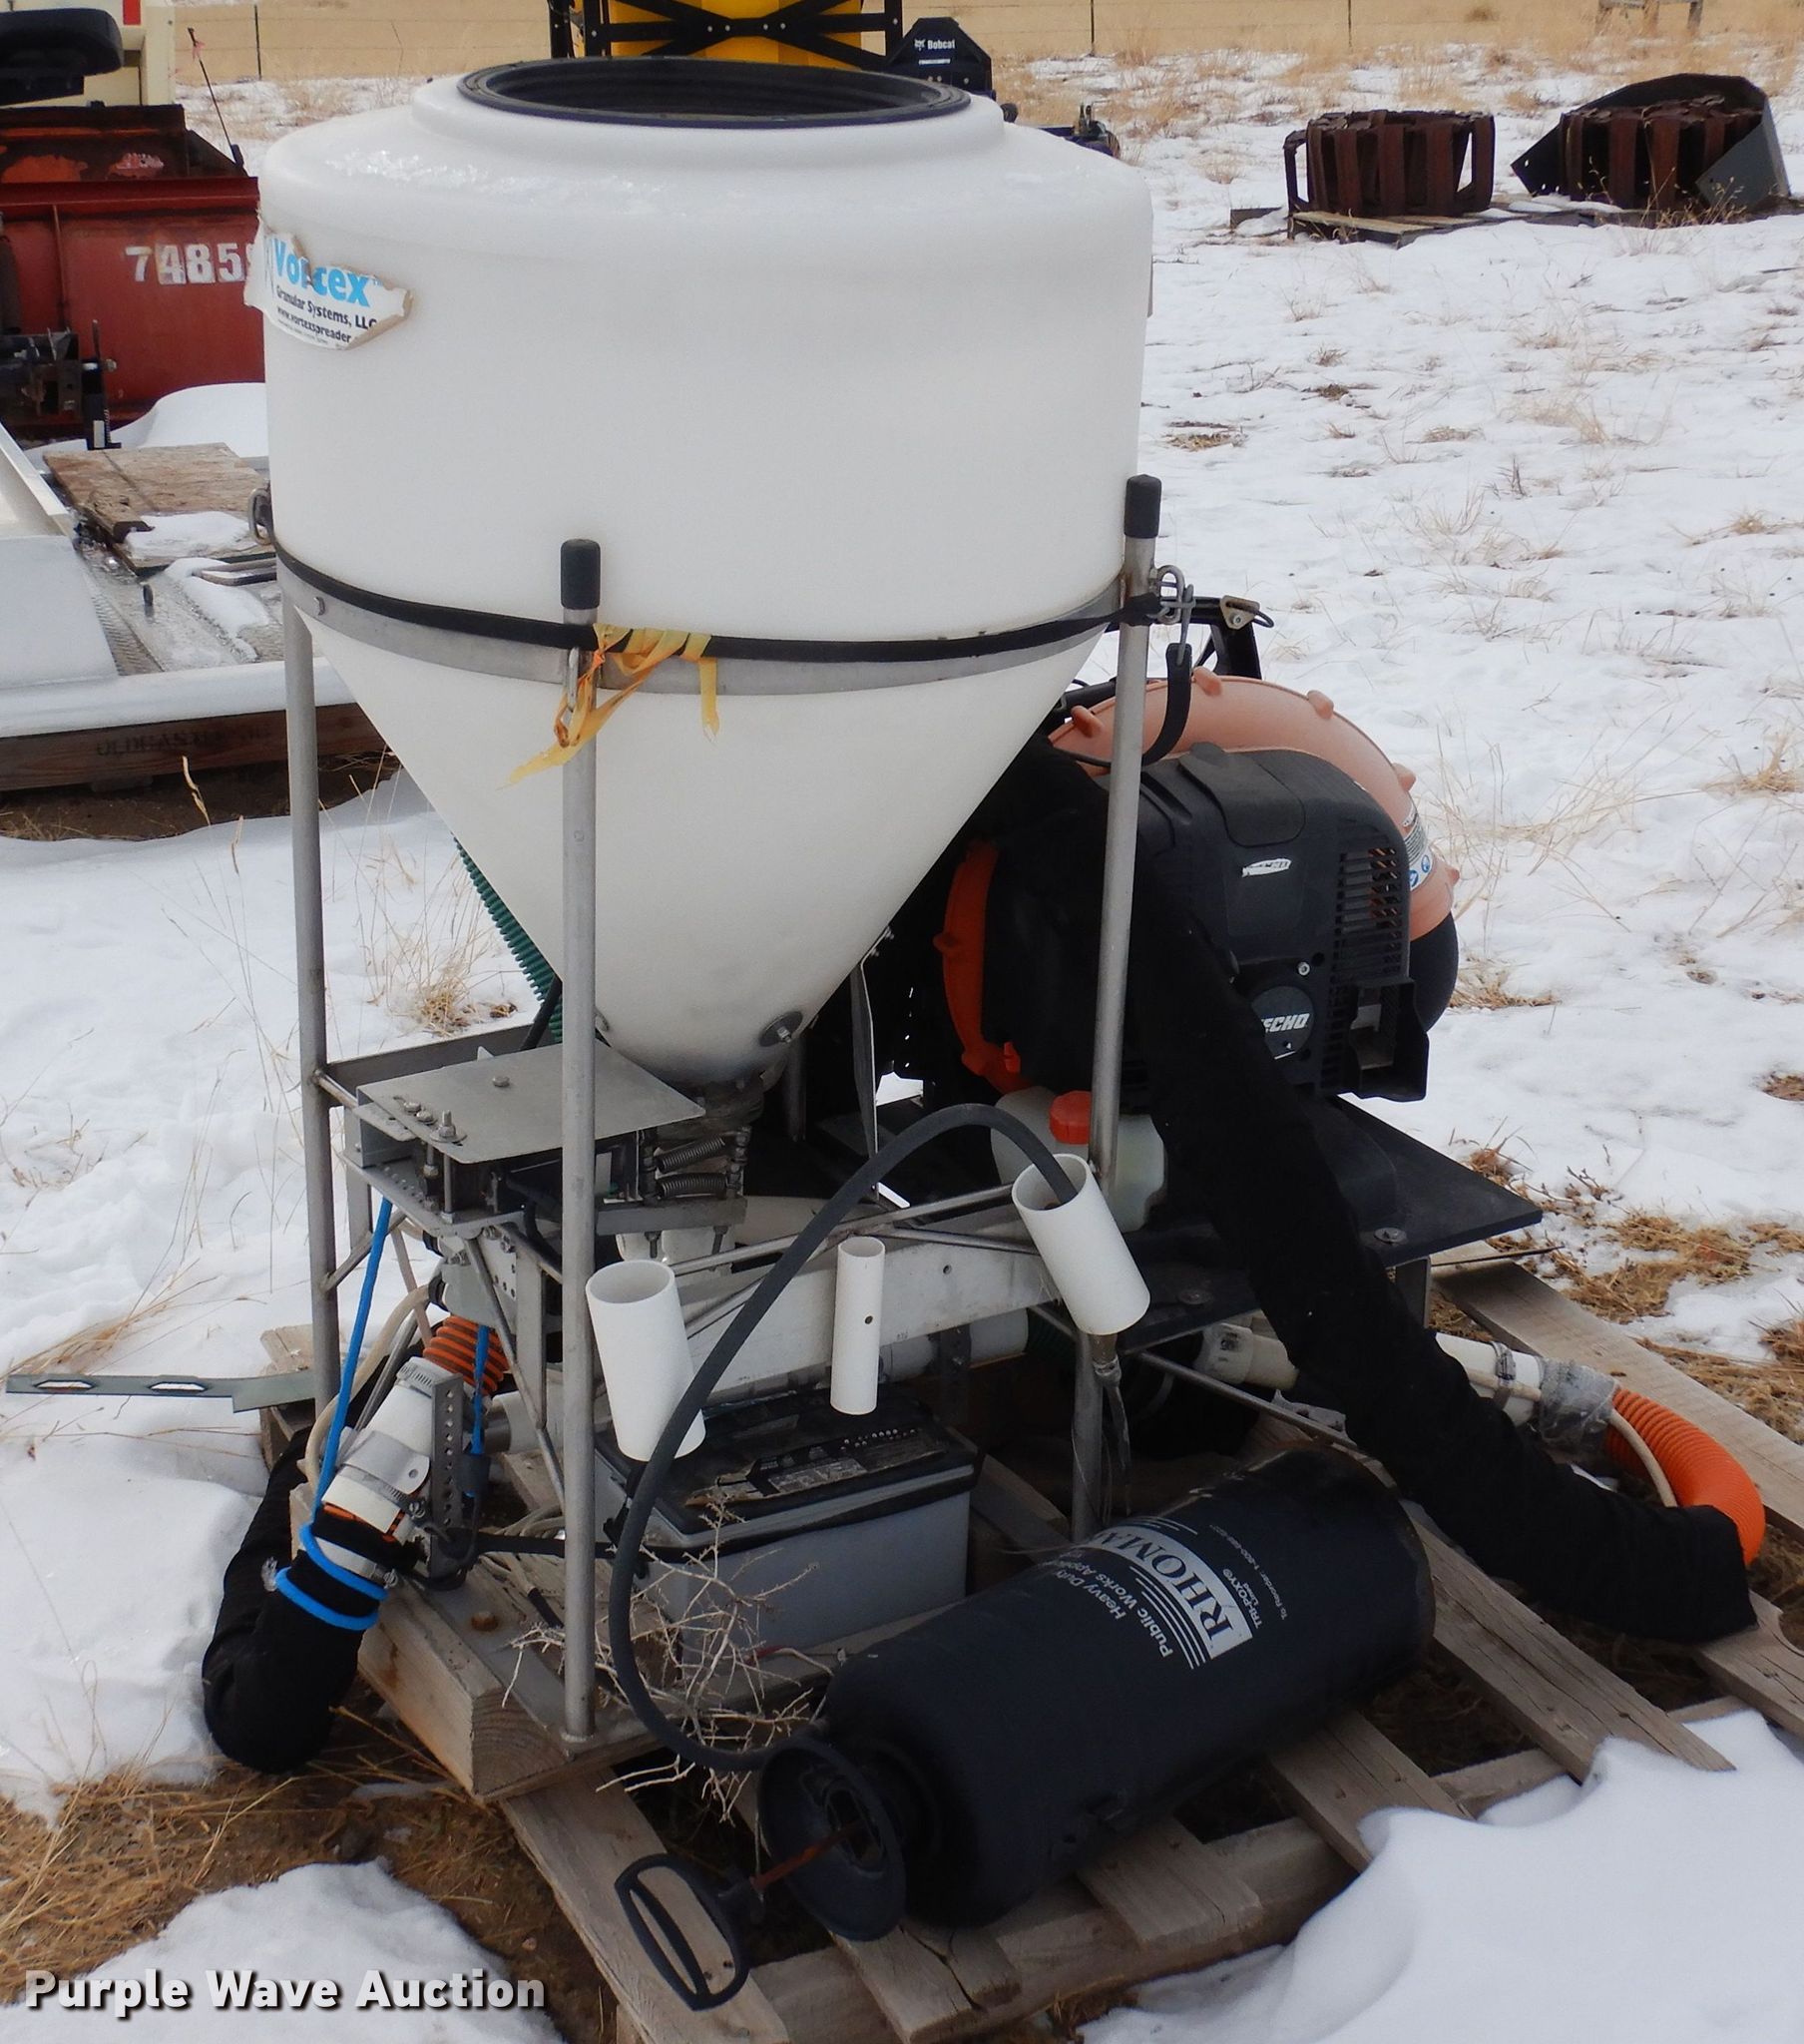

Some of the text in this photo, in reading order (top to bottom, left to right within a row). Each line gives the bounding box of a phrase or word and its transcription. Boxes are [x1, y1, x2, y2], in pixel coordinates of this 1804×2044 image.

[927, 39, 956, 50] Bobcat
[307, 298, 352, 328] Systems,
[1055, 1568, 1128, 1621] Heavy Duty
[1095, 1572, 1139, 1610] Works
[1136, 1609, 1174, 1659] Public
